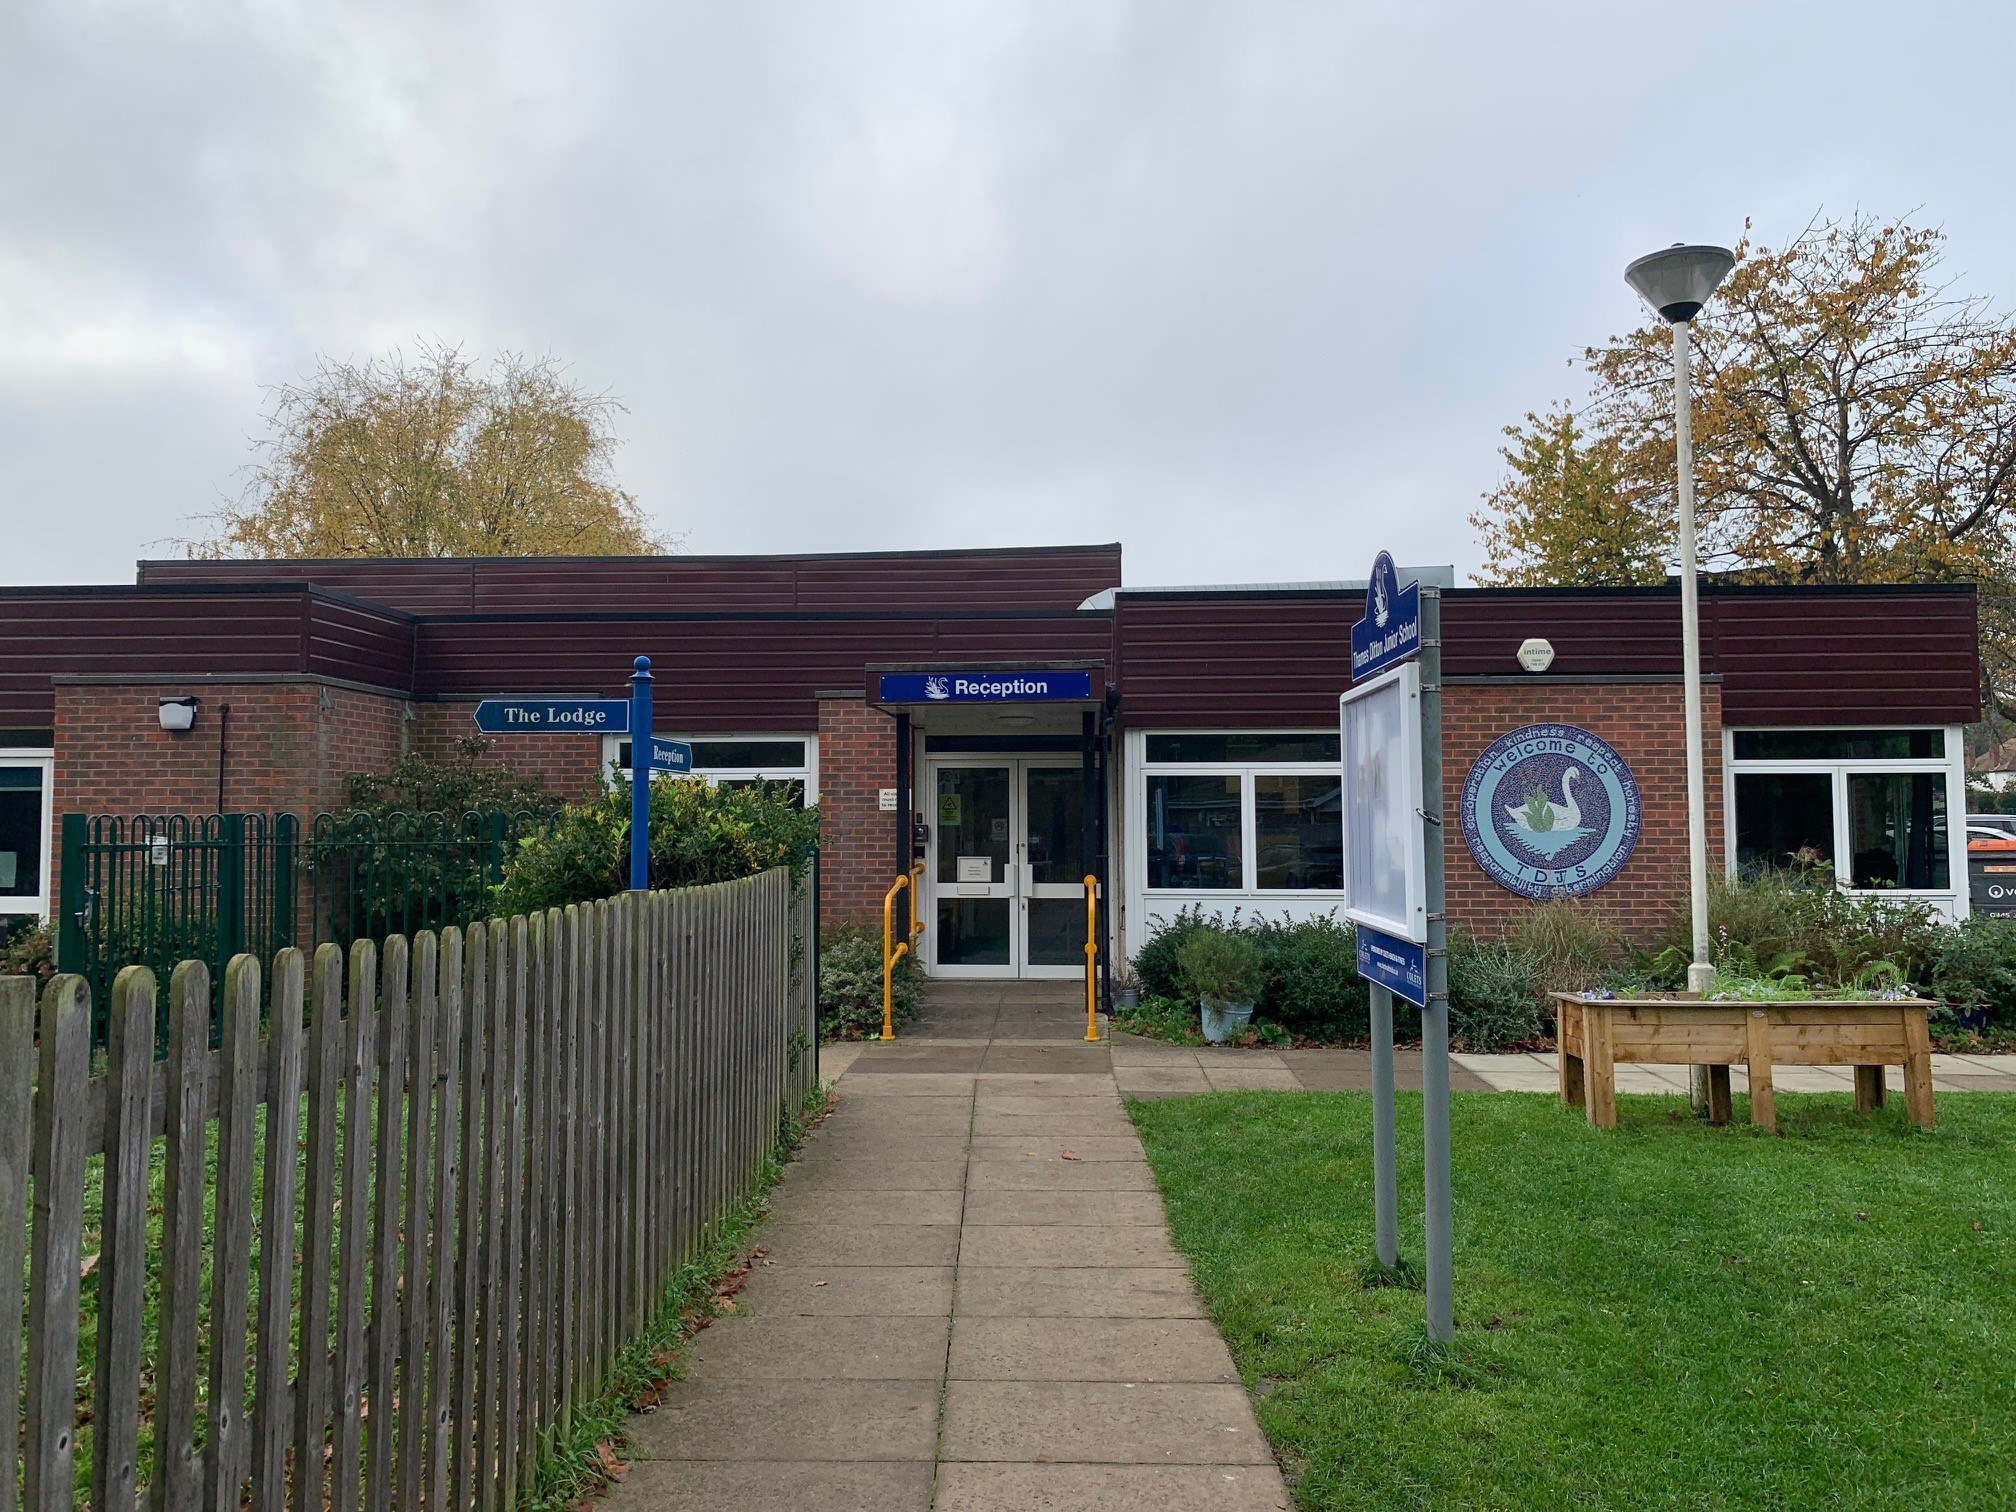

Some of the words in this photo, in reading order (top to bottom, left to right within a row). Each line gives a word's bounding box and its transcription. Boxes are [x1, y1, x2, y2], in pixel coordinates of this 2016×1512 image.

[1353, 649, 1369, 669] Thames
[1370, 640, 1383, 661] Ditton
[1384, 630, 1398, 654] Junior
[1398, 616, 1417, 645] School
[1523, 648, 1551, 656] intime
[955, 679, 1048, 697] Reception
[504, 707, 541, 723] The
[547, 707, 606, 726] Lodge
[653, 745, 684, 764] Reception
[1493, 740, 1576, 772] welcome
[1587, 752, 1608, 774] to
[1505, 728, 1565, 747] kindness
[1576, 734, 1623, 772] respect
[1622, 780, 1639, 837] honesty
[1472, 838, 1543, 897] responsibility
